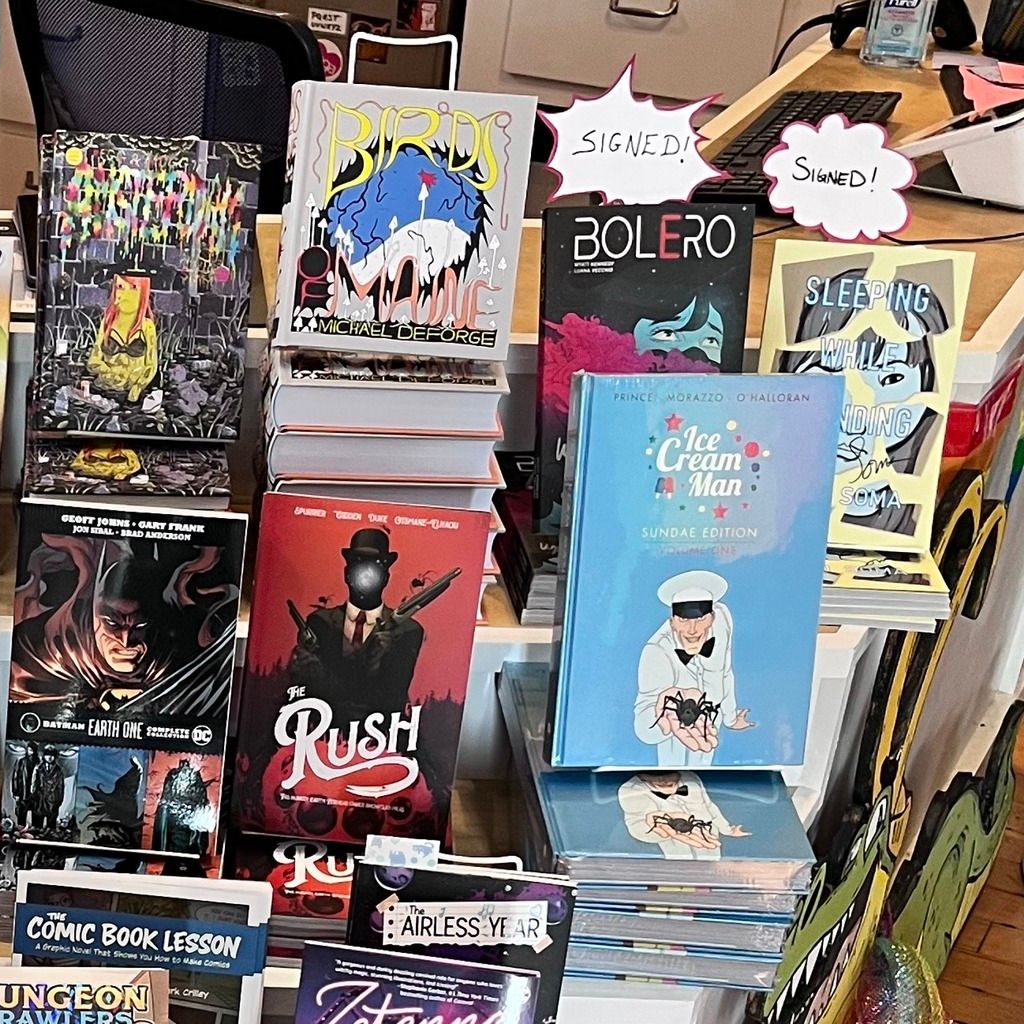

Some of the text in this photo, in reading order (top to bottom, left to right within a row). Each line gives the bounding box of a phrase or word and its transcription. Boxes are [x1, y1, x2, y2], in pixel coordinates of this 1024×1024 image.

[324, 102, 499, 210] BIRDS
[572, 130, 691, 164] SIGNED!
[792, 157, 879, 192] SIGNED!
[573, 213, 737, 261] BOLERO
[804, 275, 931, 314] SLEEPING
[317, 317, 496, 347] MICHAEL DEFORGE
[820, 336, 900, 372] WHILE
[613, 393, 811, 403] PRINCE MORAZZO O'HALLORAN
[682, 425, 720, 453] Ice
[656, 437, 742, 473] Cream
[687, 472, 743, 498] Man
[840, 487, 901, 509] SOMA
[73, 525, 191, 541] JON BRAD ANDERSON
[97, 516, 205, 533] JOHNS GARY FRANK
[641, 526, 758, 538] SUNDAE EDITION
[287, 686, 306, 700] THE
[42, 718, 144, 740] BATMAN EARTH ONE
[47, 911, 67, 922] THE
[410, 904, 426, 916] The
[27, 915, 242, 959] COMIC BOOK LESSON
[401, 916, 481, 939] AIRLESS
[94, 948, 111, 957] That
